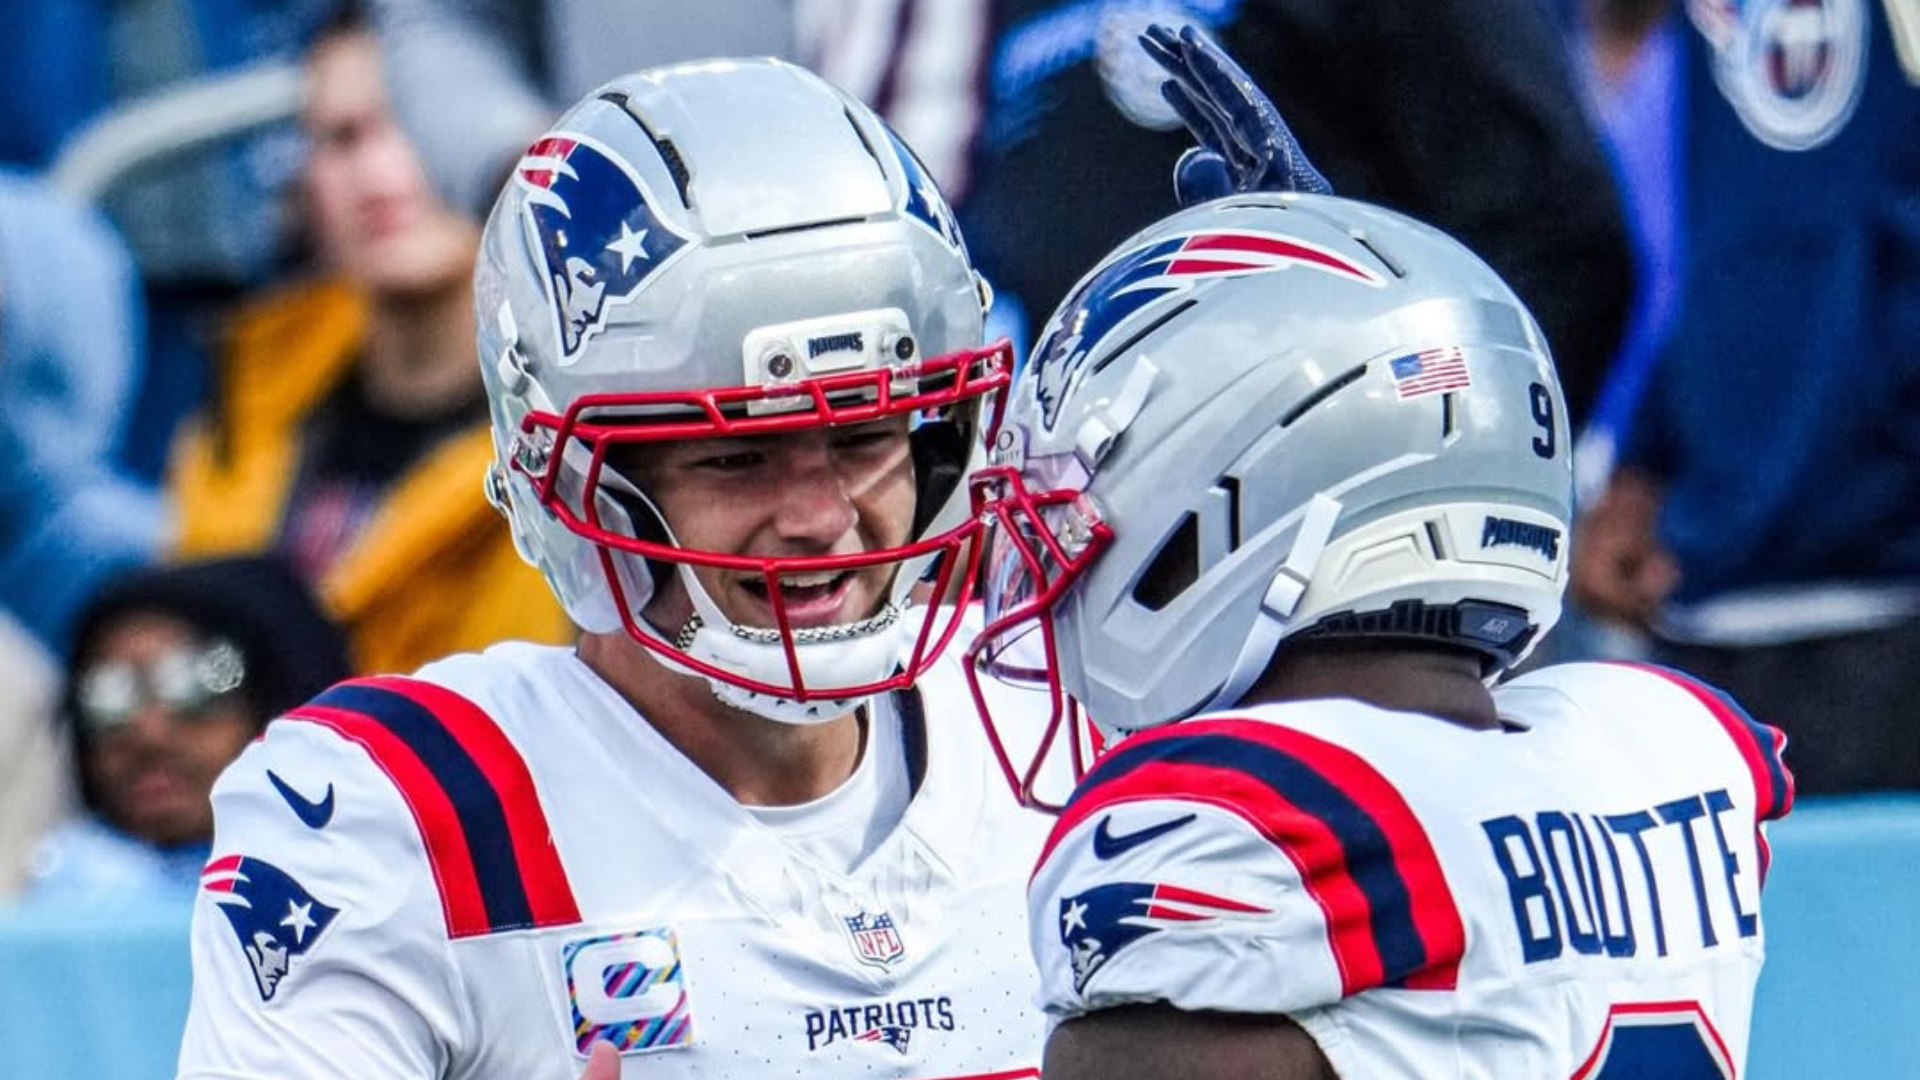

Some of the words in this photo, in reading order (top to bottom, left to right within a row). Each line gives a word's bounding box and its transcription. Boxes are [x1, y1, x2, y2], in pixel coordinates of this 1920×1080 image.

[1529, 382, 1555, 460] 9
[1480, 788, 1758, 965] BOUTTE
[858, 930, 899, 956] NFL
[805, 996, 955, 1051] PATRIOTS
